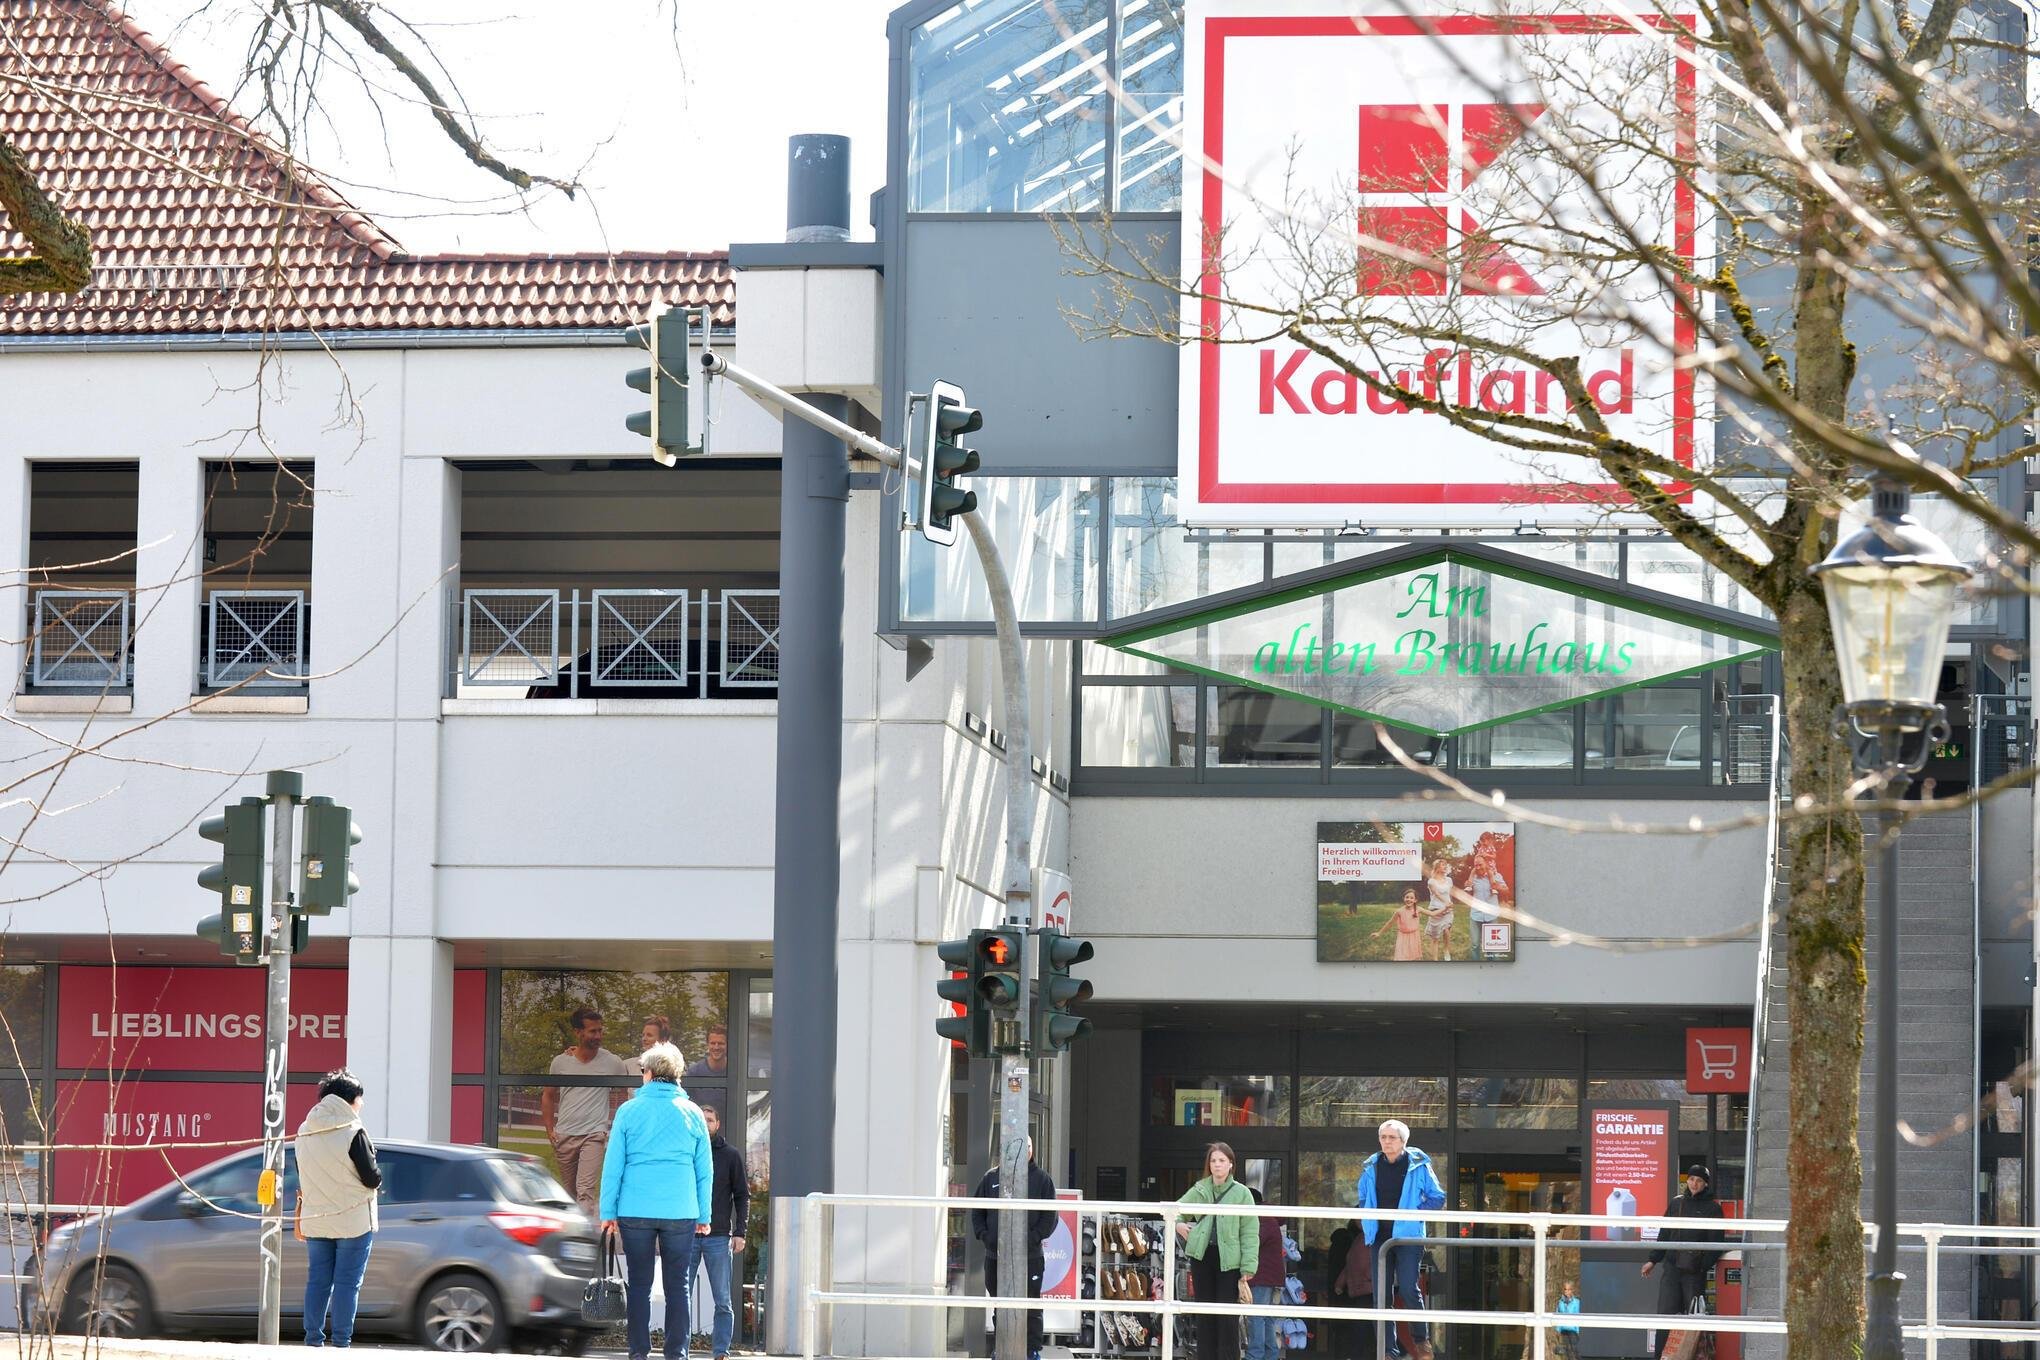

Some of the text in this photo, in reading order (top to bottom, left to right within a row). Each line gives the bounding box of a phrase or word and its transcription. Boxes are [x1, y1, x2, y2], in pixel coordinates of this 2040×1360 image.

[1259, 348, 1634, 415] Kaufland
[1396, 573, 1489, 619] Am
[1253, 622, 1638, 676] alten Brauhaus
[1322, 847, 1417, 856] Herzlich willkommen
[1322, 858, 1405, 866] in Ihrem Kaufland
[1322, 867, 1364, 877] Freiberg.
[1596, 1113, 1637, 1122] FRISCHE-
[1596, 1123, 1664, 1135] GARANTIE
